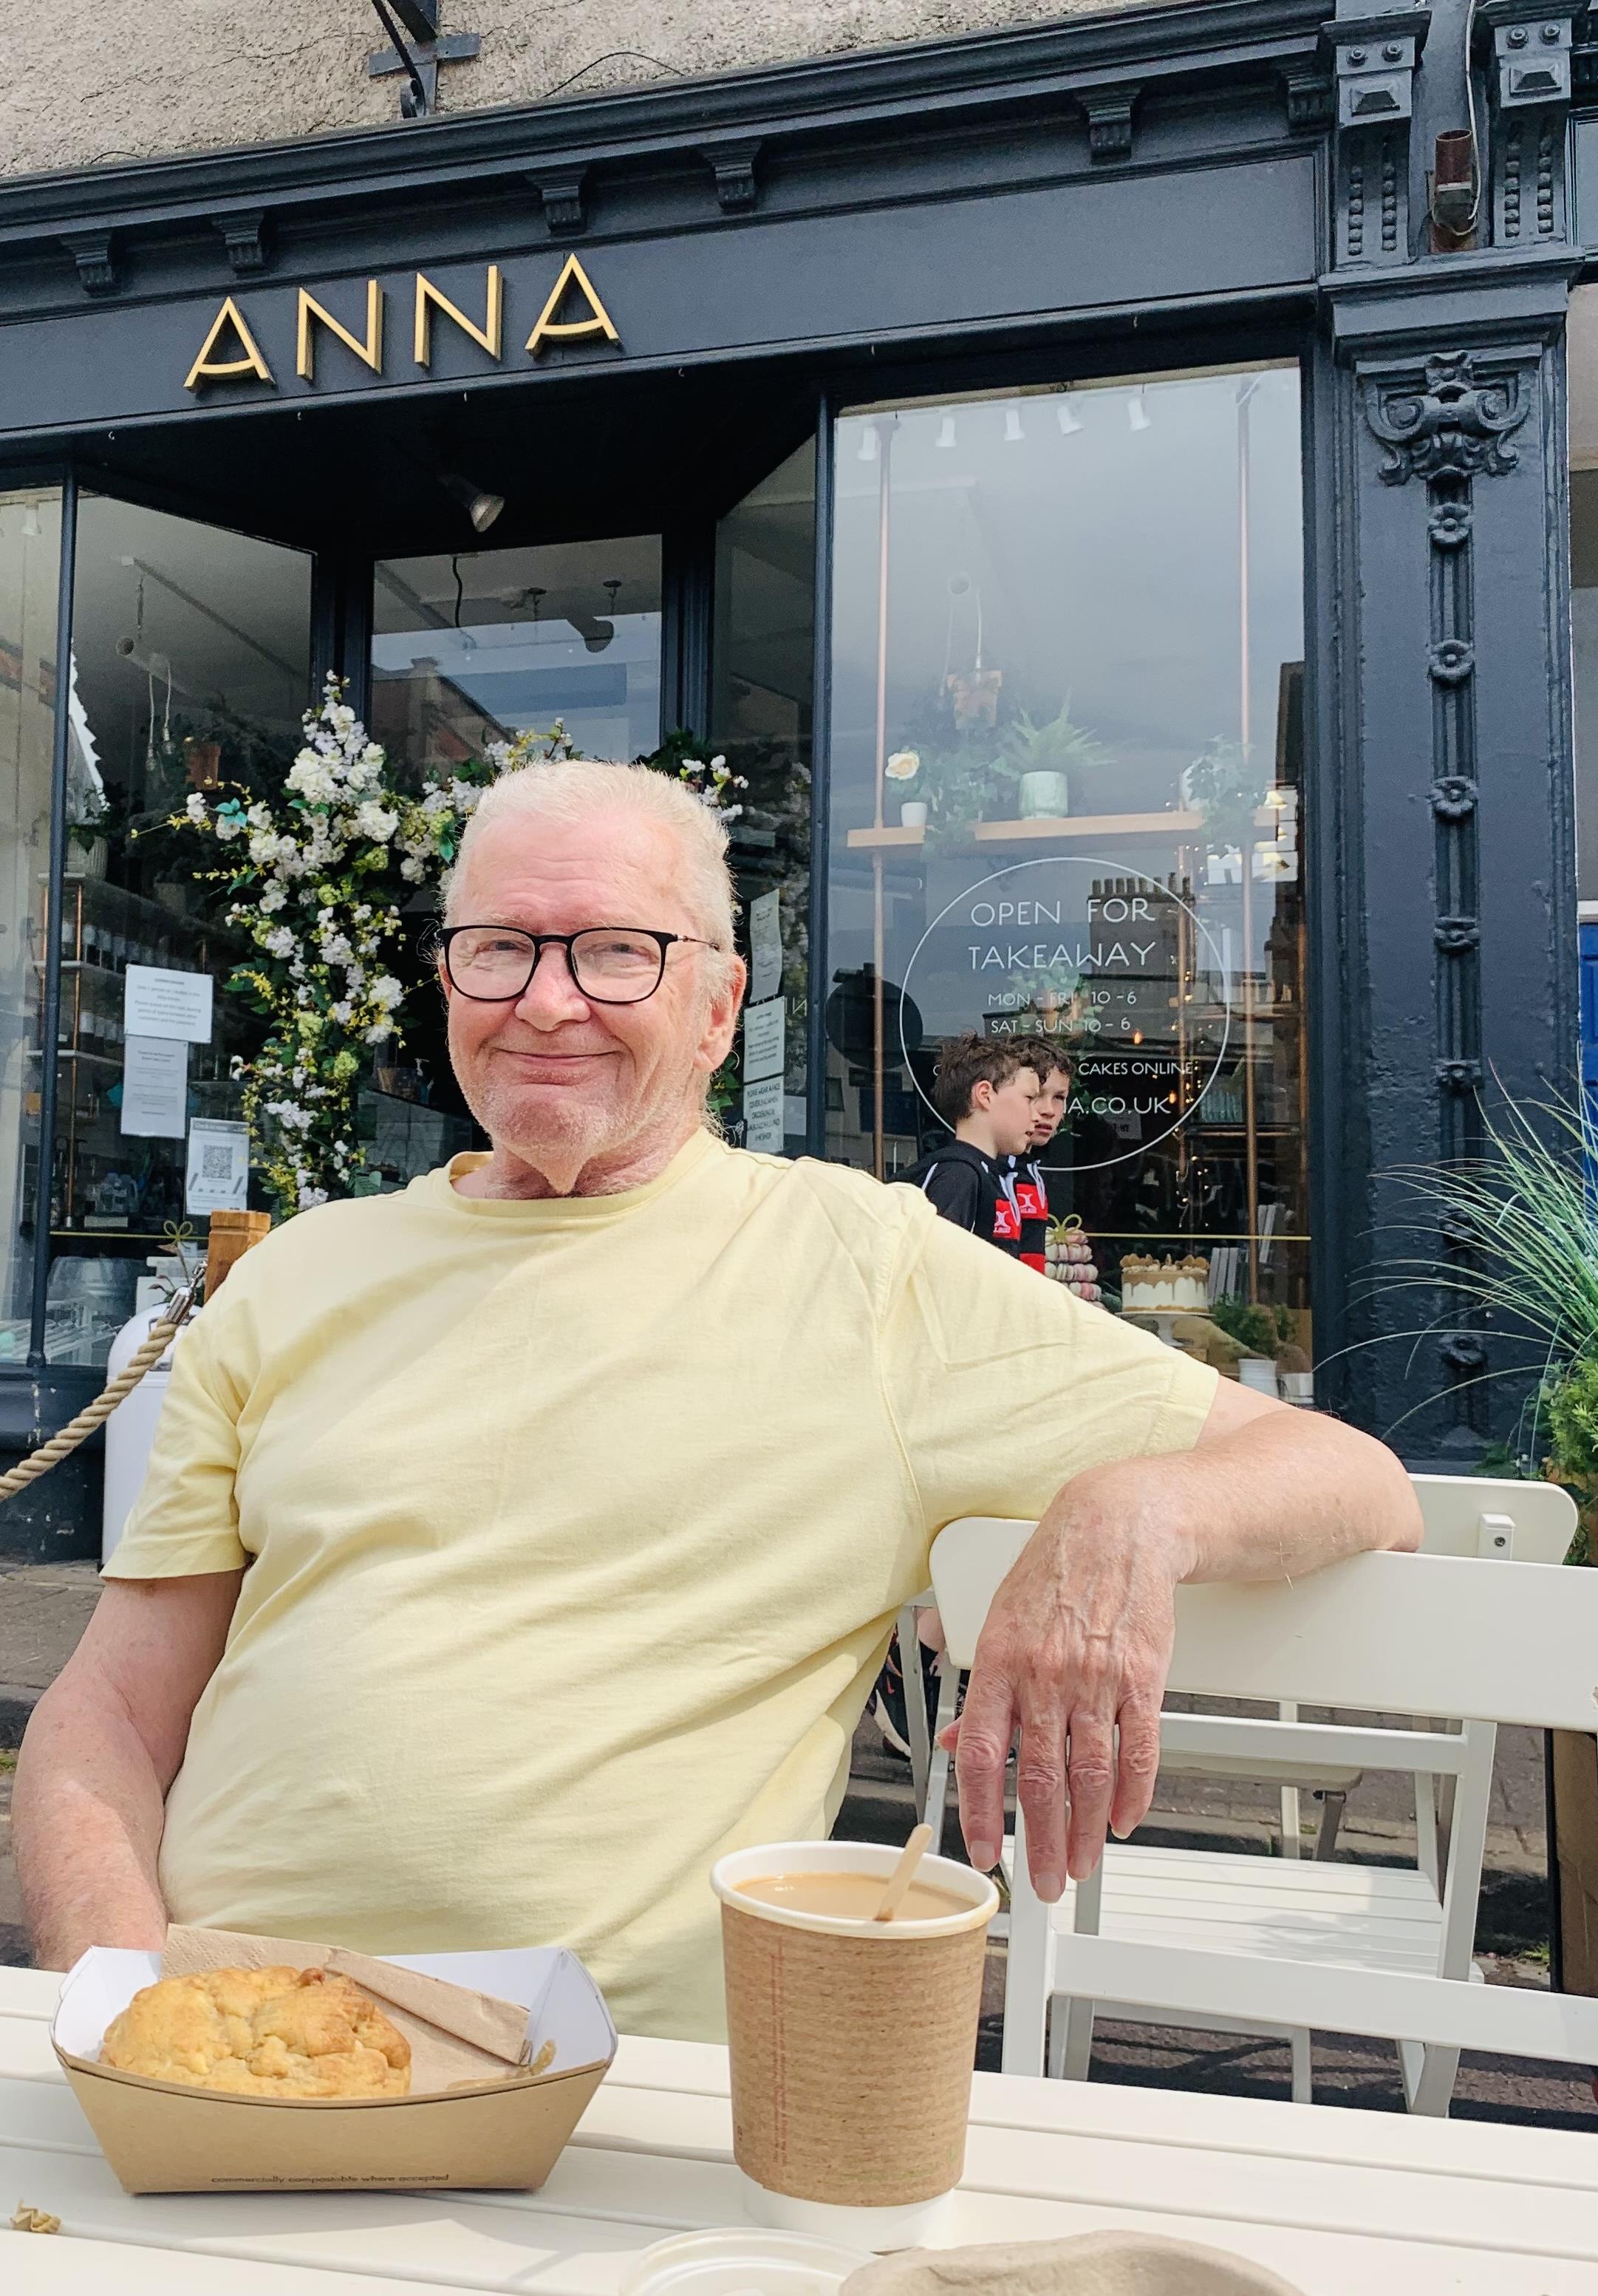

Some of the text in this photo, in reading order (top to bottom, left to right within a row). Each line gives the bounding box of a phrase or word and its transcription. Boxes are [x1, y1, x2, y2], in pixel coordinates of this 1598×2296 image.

[183, 252, 621, 394] ANNA
[970, 898, 1156, 927] OPEN FOR
[968, 941, 1157, 970] TAKEAWAY
[988, 992, 1031, 1006] MON
[1049, 992, 1074, 1005] FRI
[1090, 990, 1111, 1004] 10
[991, 1020, 1018, 1033] SAT
[1035, 1019, 1073, 1033] SUN
[1083, 1019, 1102, 1032] 10
[1120, 1017, 1131, 1031] 6
[1078, 1062, 1194, 1075] CAKES ONLINE
[1063, 1097, 1172, 1114] A.CO.UK
[211, 2173, 449, 2184] commercially compostable where accepted
